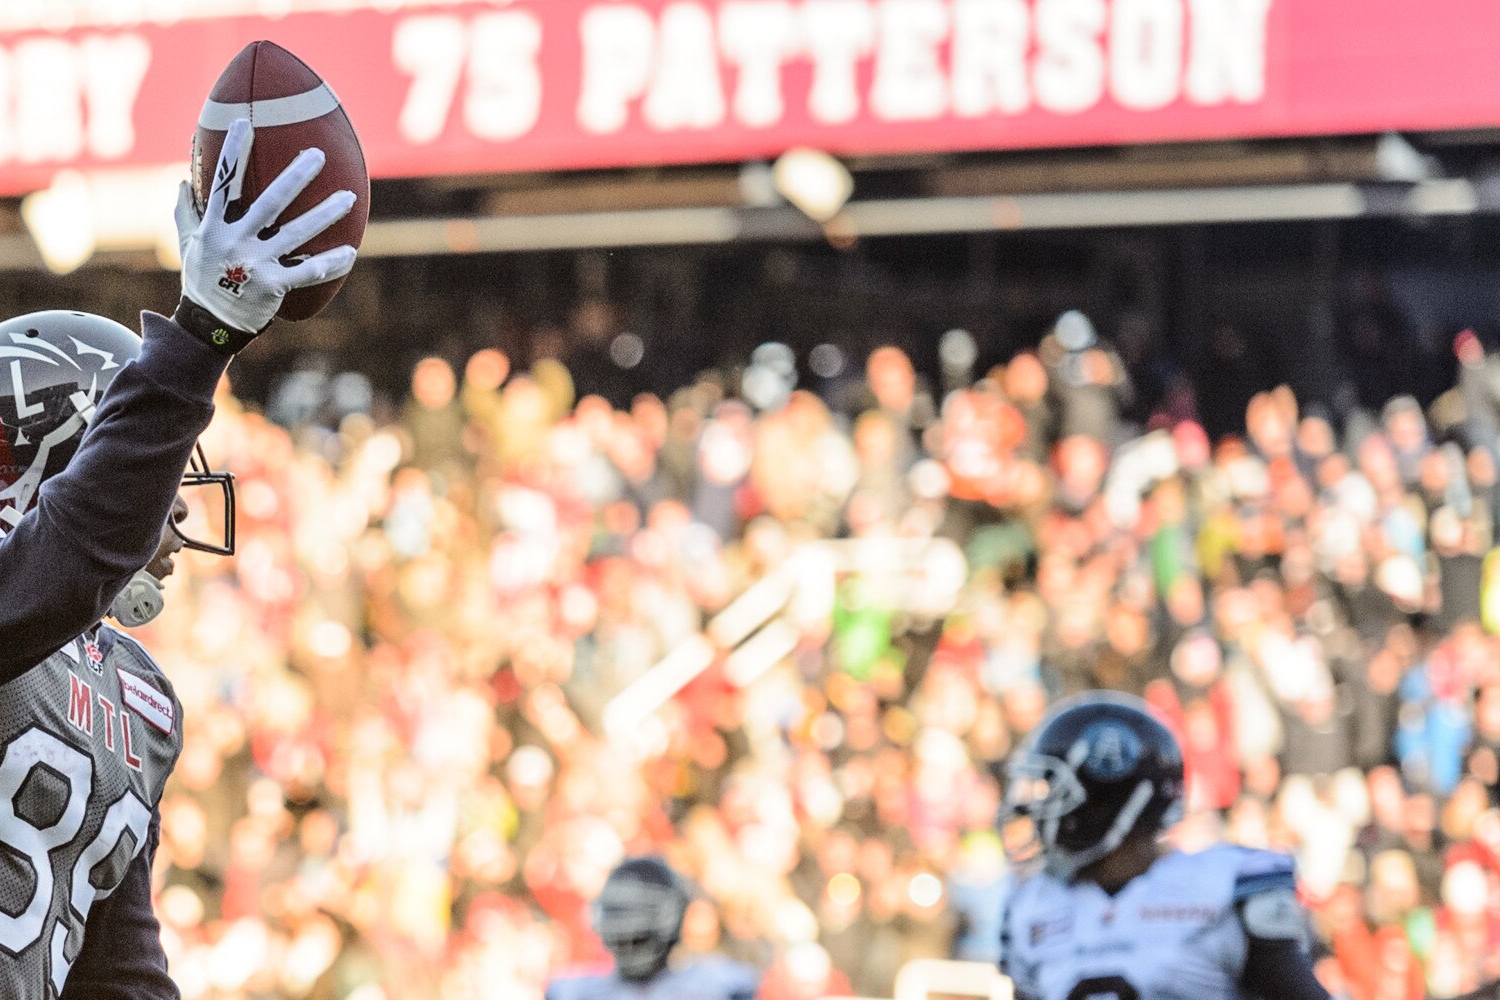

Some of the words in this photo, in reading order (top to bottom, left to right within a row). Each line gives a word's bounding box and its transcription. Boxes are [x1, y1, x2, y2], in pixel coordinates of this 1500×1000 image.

[392, 13, 542, 143] 75
[575, 0, 1272, 134] PATTERSON
[218, 277, 240, 295] CFL
[67, 668, 143, 773] MTL
